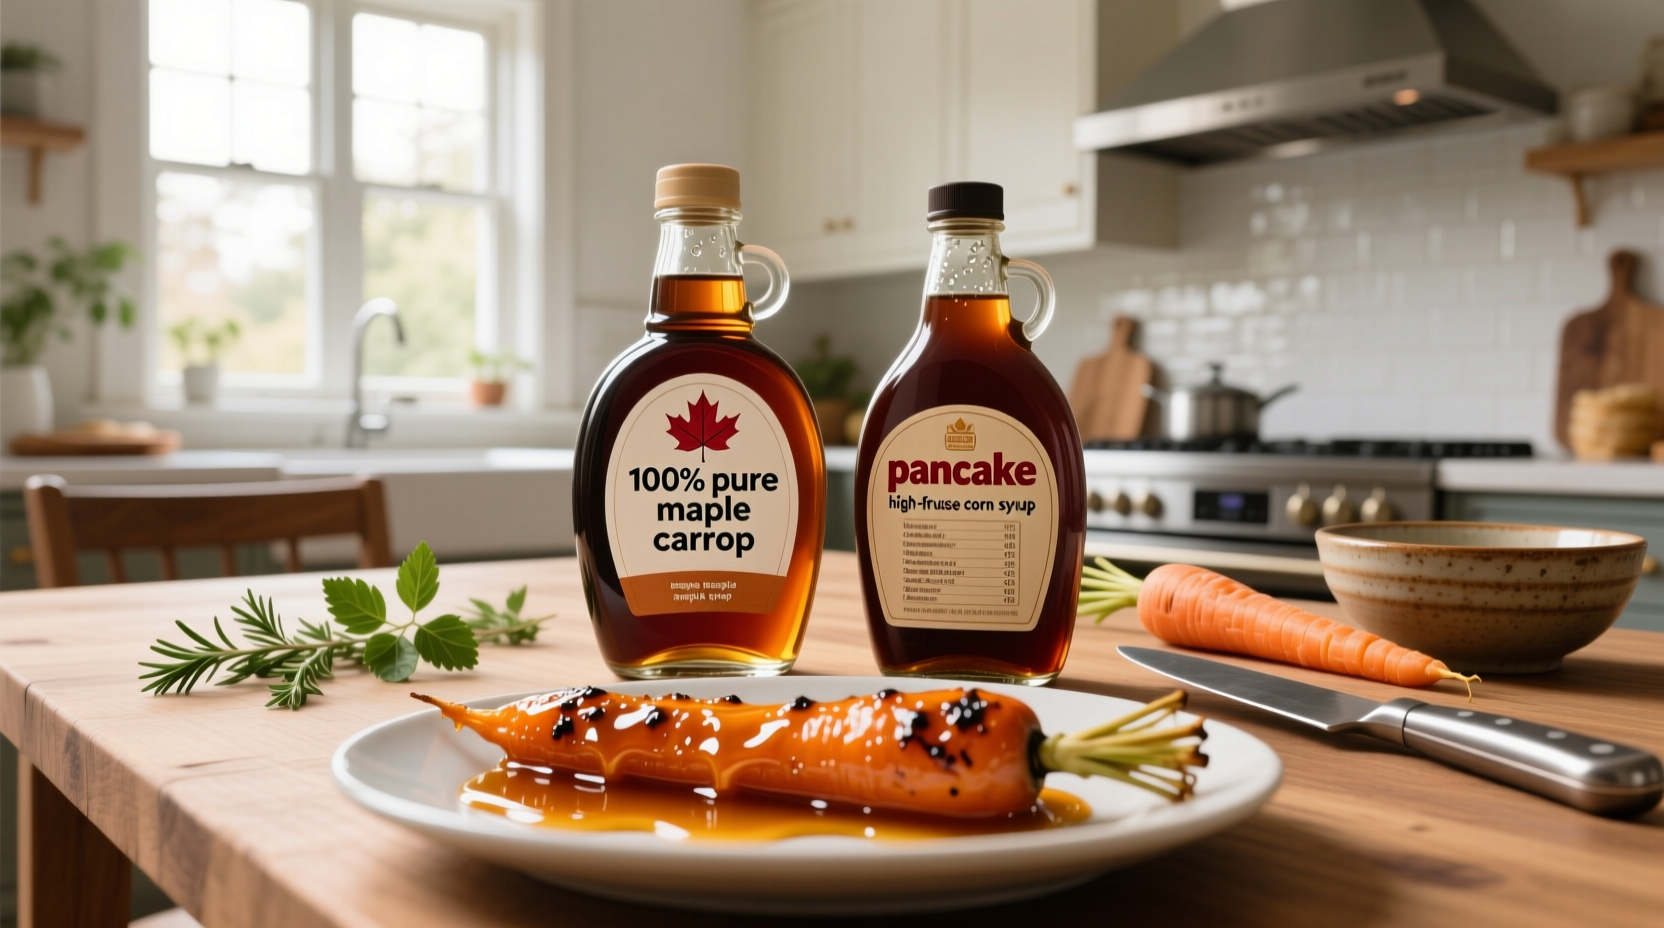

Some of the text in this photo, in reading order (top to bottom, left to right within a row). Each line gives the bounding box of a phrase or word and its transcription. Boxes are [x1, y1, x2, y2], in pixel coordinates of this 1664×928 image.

[628, 466, 779, 498] 100% pure
[887, 451, 1038, 493] pancake
[657, 495, 751, 528] maple
[963, 499, 995, 511] corn
[653, 531, 755, 559] carrop
